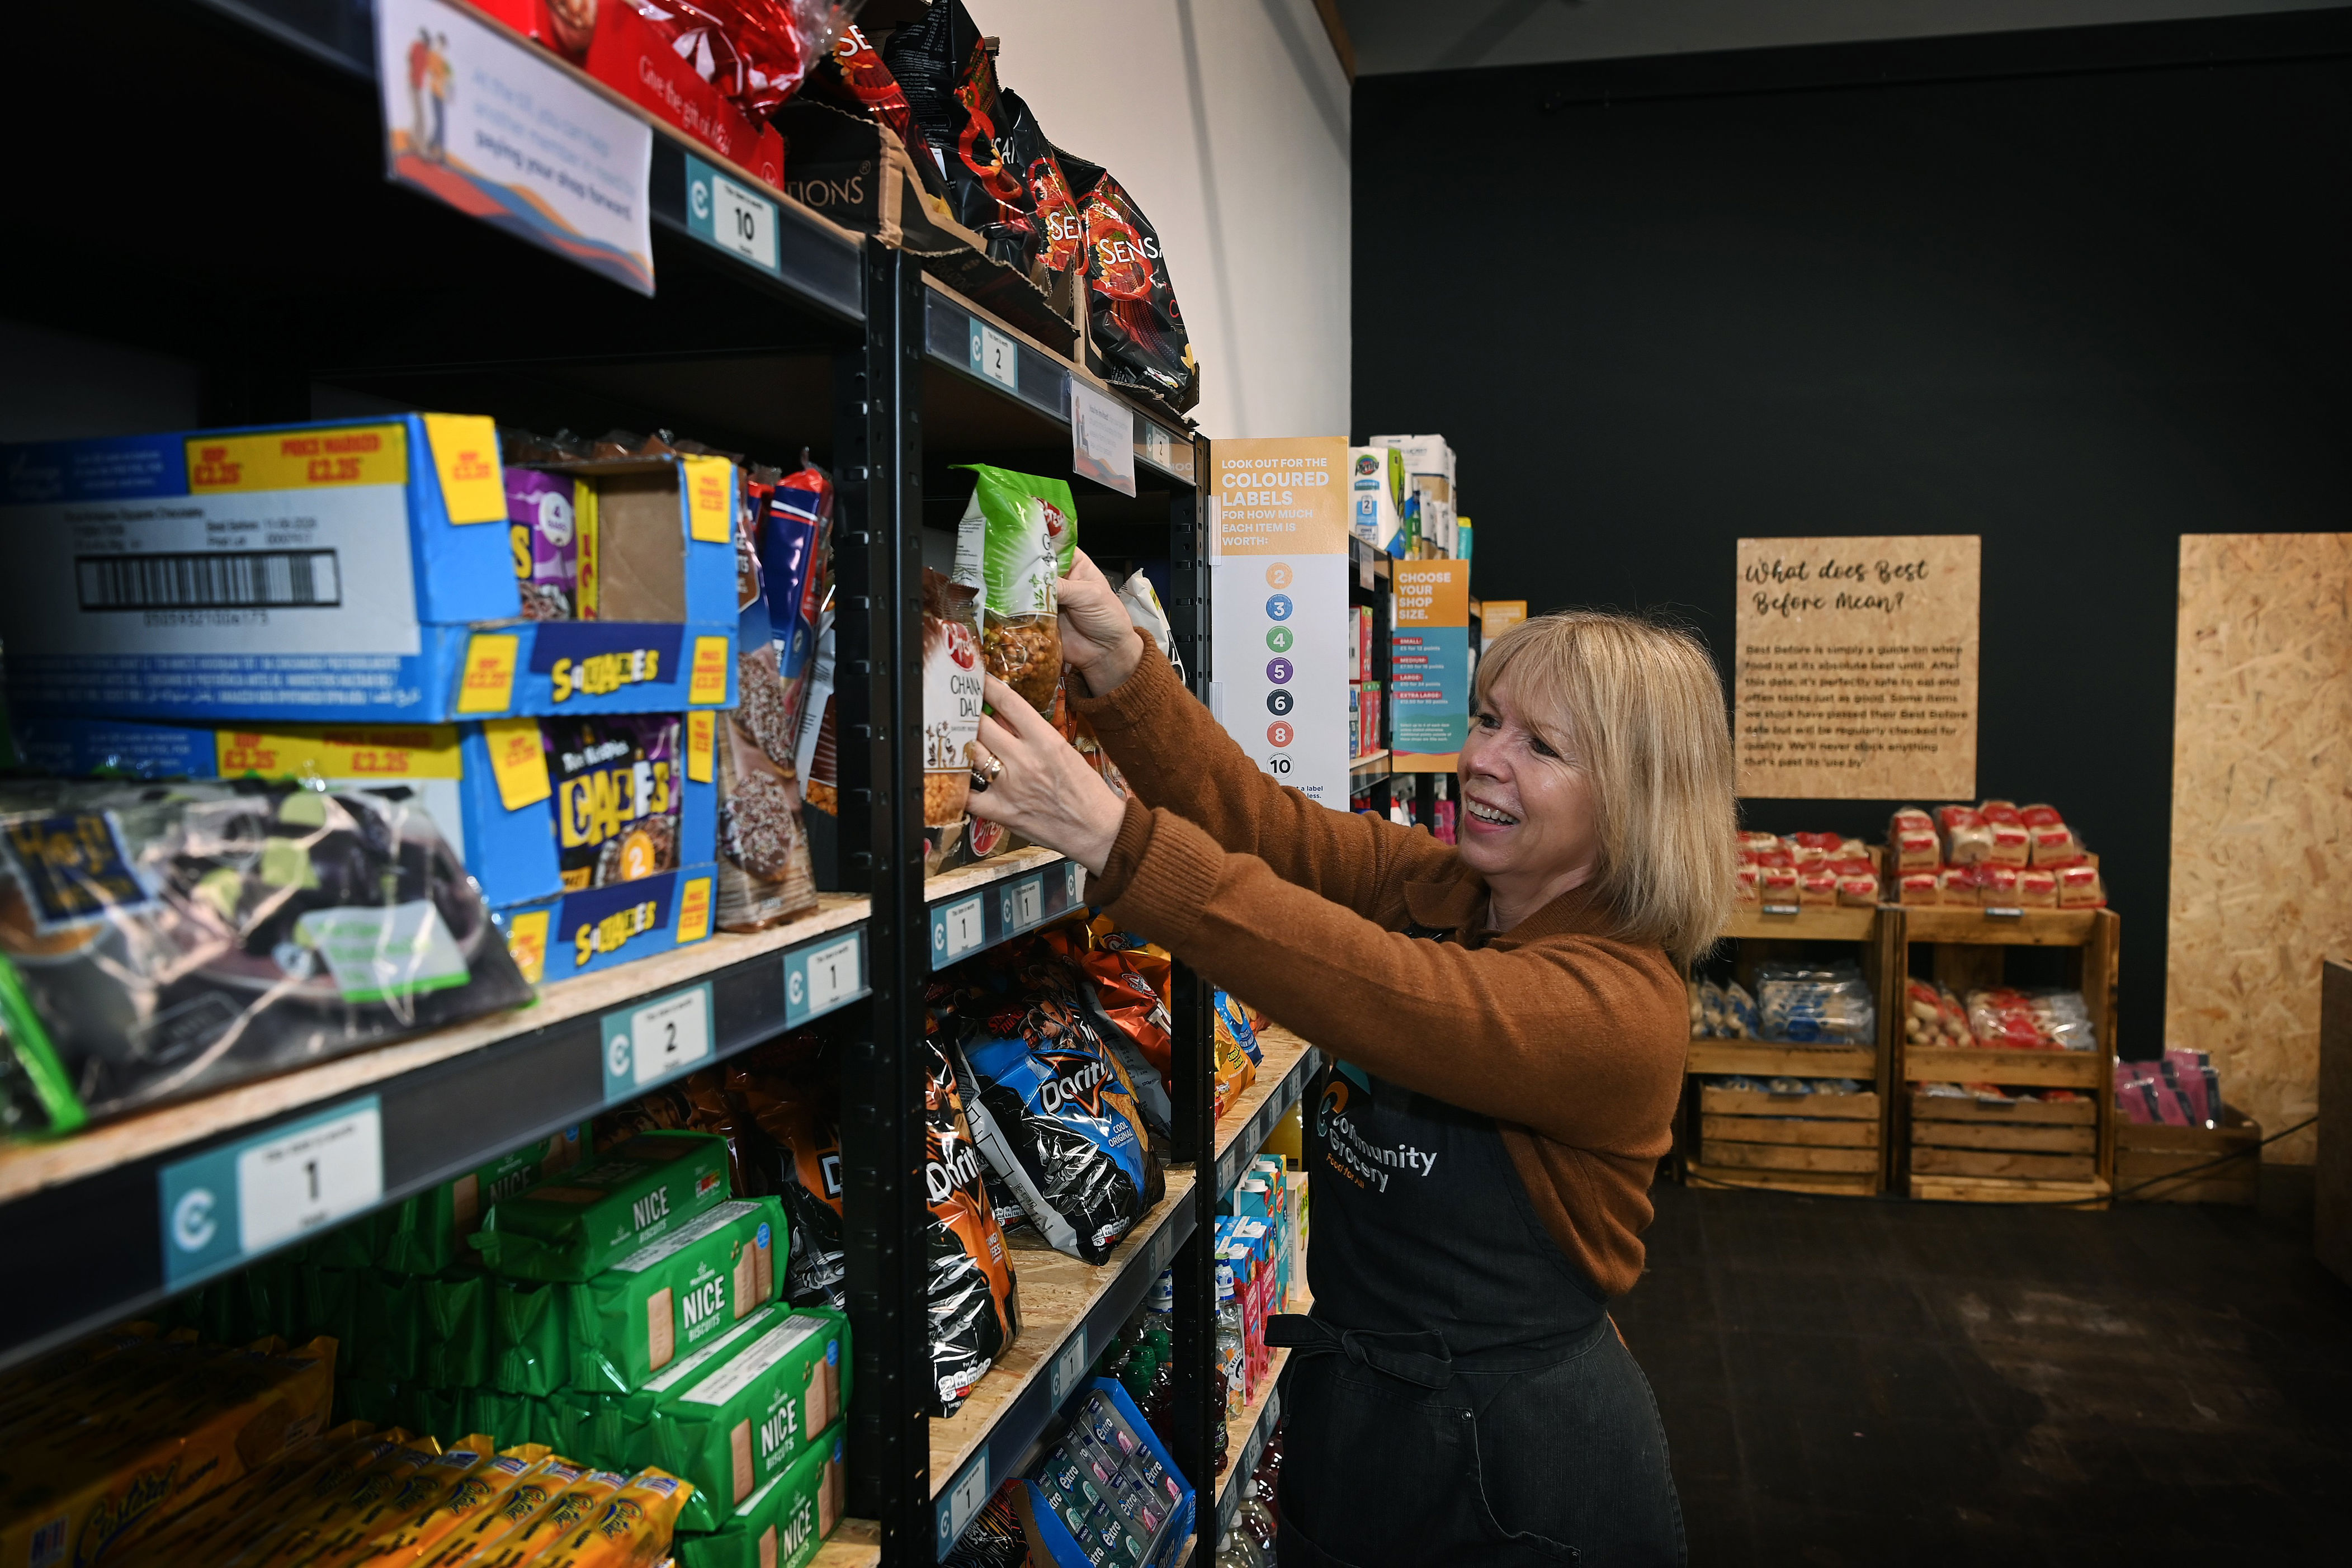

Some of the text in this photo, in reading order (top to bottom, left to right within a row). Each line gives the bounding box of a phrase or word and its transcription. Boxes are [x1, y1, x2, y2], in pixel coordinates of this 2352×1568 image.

[735, 207, 754, 241] 10
[996, 348, 1001, 369] 2
[1159, 440, 1163, 456] 2
[1222, 458, 1327, 469] LOOK OUT FOR THE
[1222, 471, 1329, 488] COLOURED
[1222, 490, 1293, 506] LABELS
[1364, 500, 1369, 509] 2
[1222, 509, 1314, 519] FOR HOW MUCH
[1222, 523, 1296, 532] EACH ITEM IS
[1222, 537, 1268, 546] WORTH:
[1274, 570, 1284, 584] 2
[1399, 572, 1451, 583] CHOOSE
[1746, 559, 1929, 584] What does Best
[1399, 584, 1433, 596] YOUR
[1274, 602, 1284, 616] 3
[1399, 597, 1433, 608] SHOP
[1753, 591, 1904, 617] Before Mean?
[1399, 609, 1428, 620] SIZE.
[1273, 633, 1285, 647] 4
[1746, 646, 1770, 654] Best
[1774, 646, 1811, 654] Before
[1274, 665, 1285, 679] 5
[960, 698, 980, 717] DAL
[1274, 696, 1286, 711] 6
[1275, 728, 1286, 742] 8
[1270, 759, 1291, 773] 10
[629, 846, 646, 879] 2
[1025, 898, 1029, 917] 1
[962, 918, 966, 939] 1
[830, 964, 837, 990] 1
[665, 1022, 677, 1053] 2
[1113, 1121, 1128, 1134] COOL
[1108, 1129, 1133, 1147] ORIGINAL
[1333, 1111, 1437, 1177] Community
[1326, 1153, 1344, 1173] Food
[1343, 1167, 1354, 1180] for
[1330, 1128, 1388, 1193] Grocery
[304, 1159, 320, 1202] 1
[489, 1165, 531, 1205] NICE
[632, 1186, 669, 1231] NICE
[639, 1219, 667, 1243] BISCUITS
[1163, 1240, 1165, 1256] 1
[682, 1275, 725, 1329] NICE
[688, 1313, 720, 1343] BISCUITS
[1070, 1357, 1073, 1375] 1
[761, 1397, 798, 1458] NICE
[1097, 1418, 1114, 1441] extra
[766, 1437, 794, 1471] BISCUITS
[1060, 1465, 1079, 1489] extra
[1145, 1461, 1163, 1484] extra
[966, 1488, 970, 1509] 1
[1120, 1493, 1137, 1516] extra
[784, 1499, 812, 1560] NICE
[1102, 1520, 1121, 1546] extra
